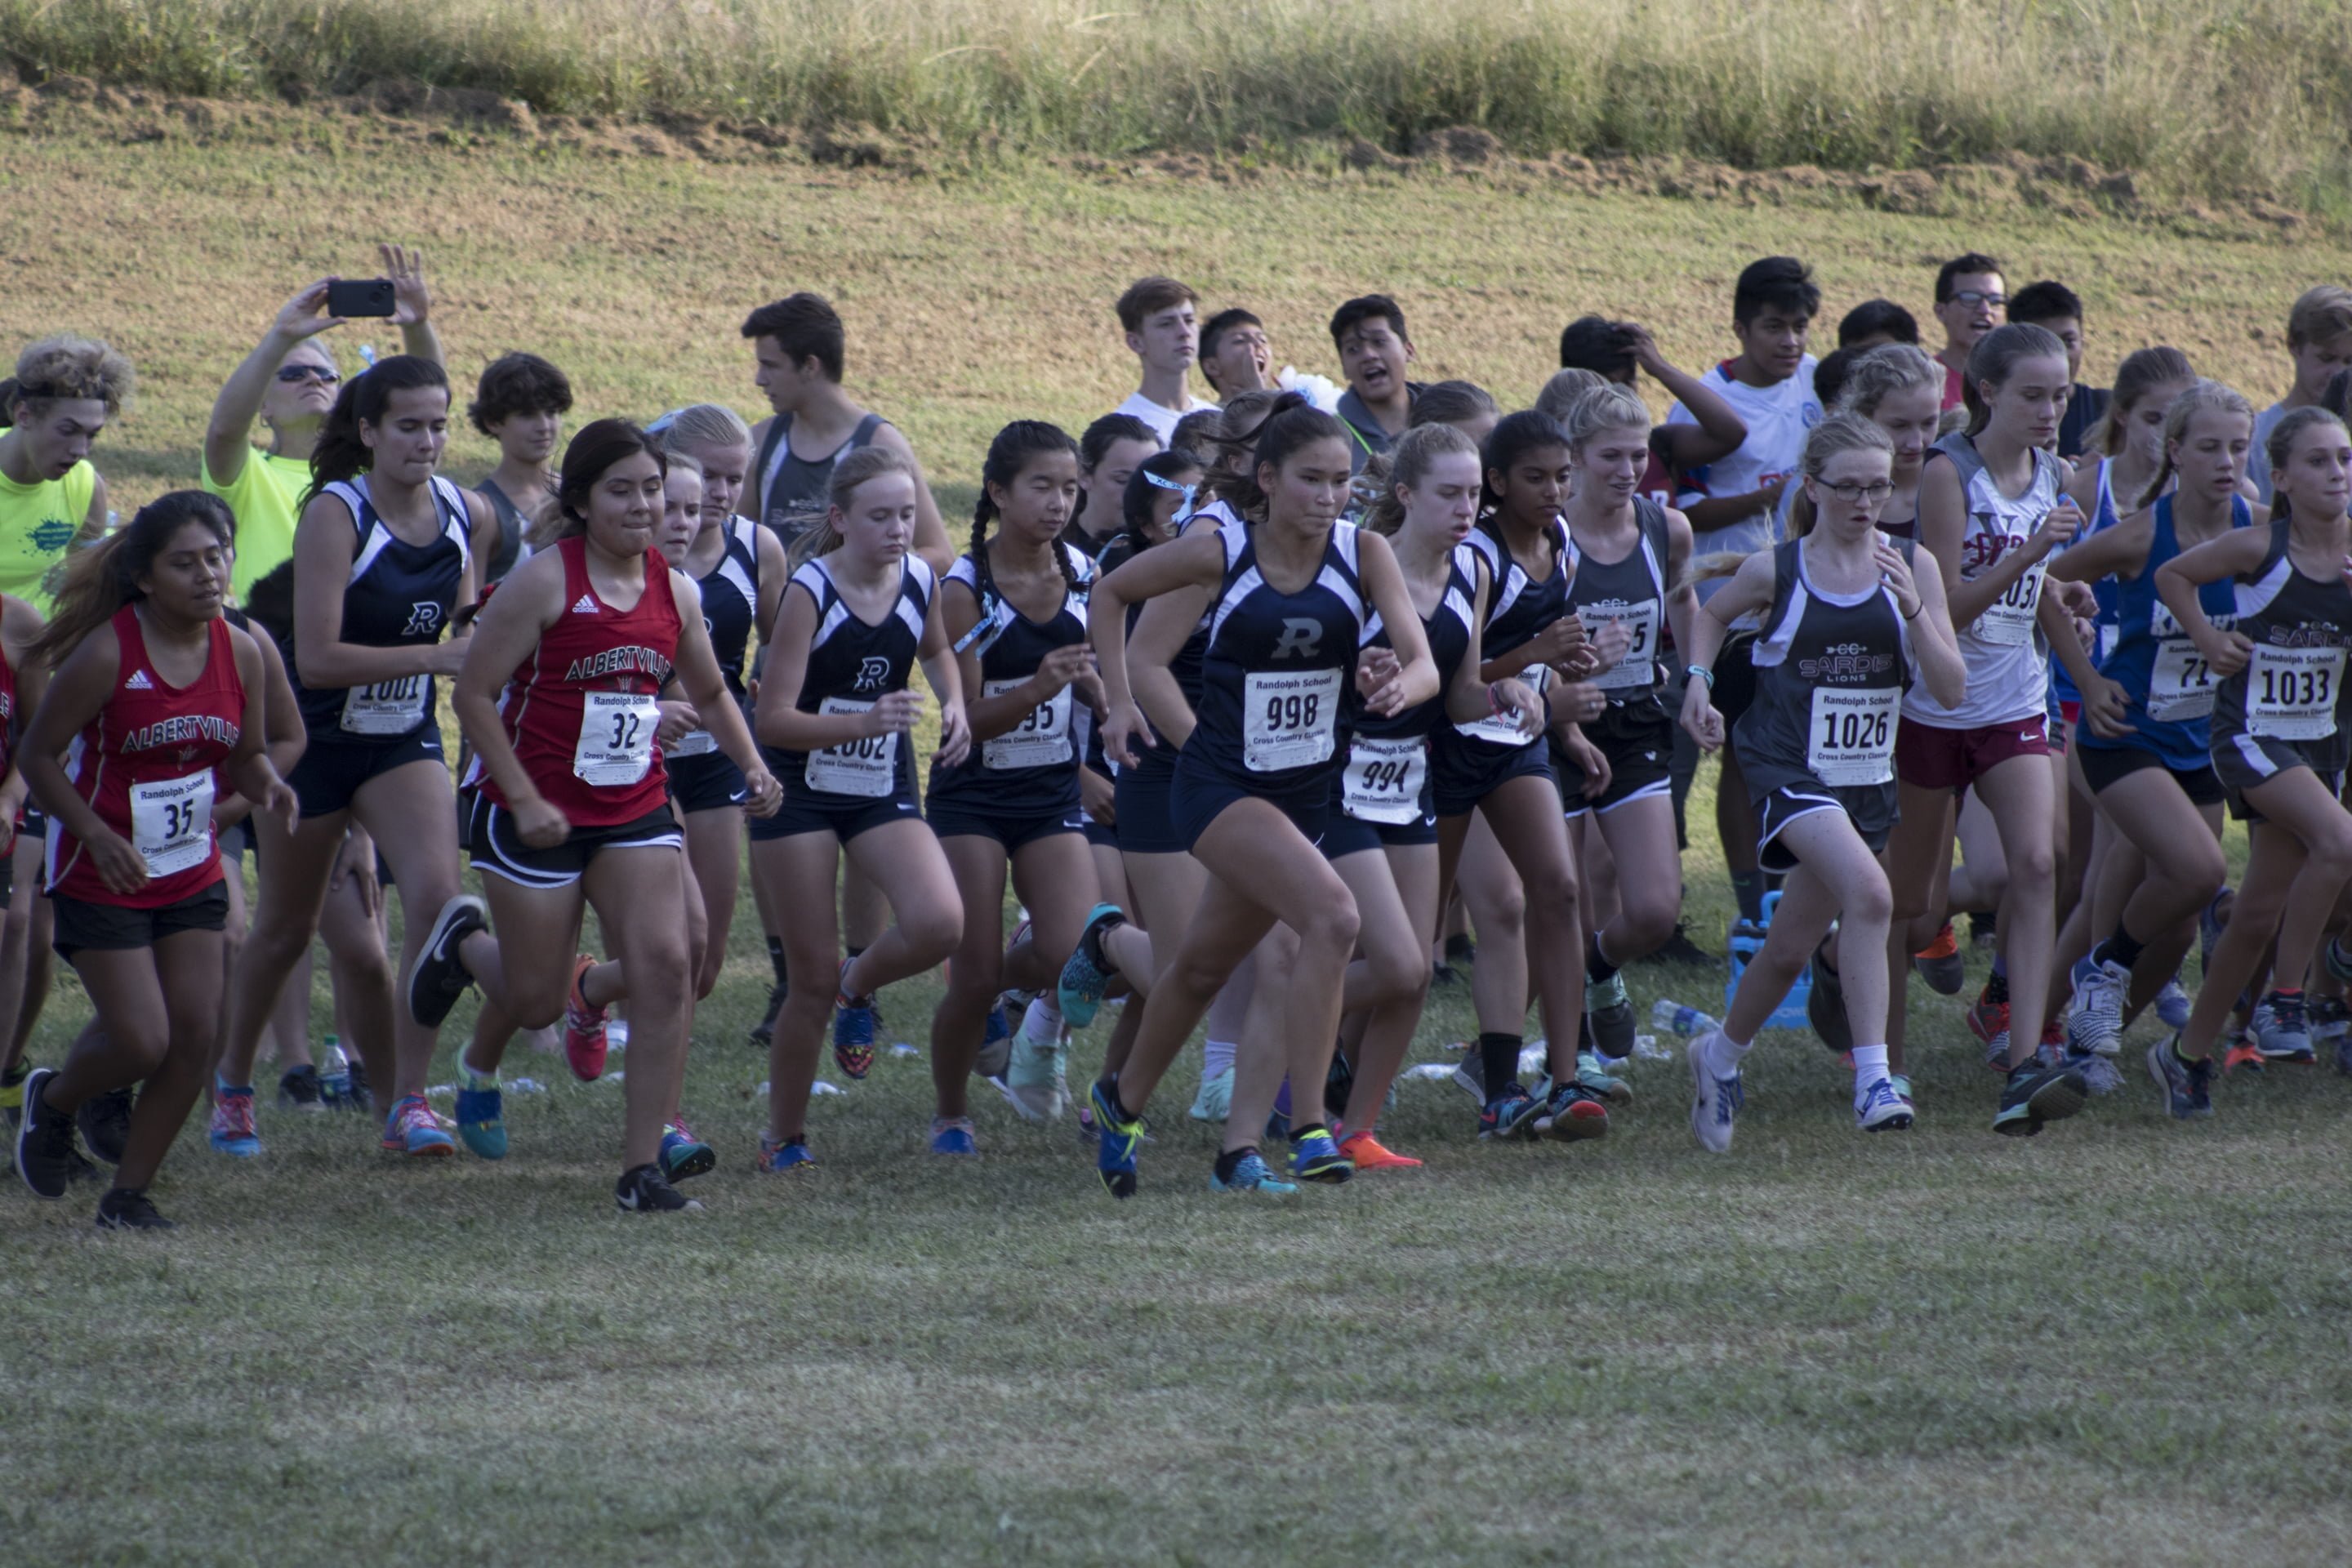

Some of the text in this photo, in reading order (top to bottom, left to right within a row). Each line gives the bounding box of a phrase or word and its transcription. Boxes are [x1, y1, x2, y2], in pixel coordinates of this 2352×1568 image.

[400, 601, 439, 635] R
[1627, 608, 1651, 621] School
[1270, 617, 1323, 659] R
[1799, 653, 1894, 677] SARDIS
[2260, 652, 2336, 665] Randolph School
[853, 656, 889, 693] R
[1827, 675, 1867, 683] LIONS
[2180, 657, 2209, 688] 71
[1256, 676, 1332, 689] Randolph School
[2261, 668, 2331, 705] 1033
[372, 703, 398, 711] Country
[594, 697, 631, 707] Randolph
[1824, 695, 1894, 707] Randolph School
[1009, 700, 1054, 733] 95
[1267, 693, 1319, 731] 998
[2255, 707, 2277, 716] Cross
[2278, 708, 2308, 718] Country
[120, 715, 239, 754] ALBERTVILLE
[608, 712, 639, 750] 32
[1823, 711, 1889, 749] 1026
[1013, 736, 1040, 744] Country
[1253, 737, 1274, 745] Cross
[1276, 733, 1302, 744] Country
[822, 733, 888, 760] 002
[1359, 743, 1397, 756] Randolph
[584, 751, 604, 760] Cross
[605, 752, 630, 761] Country
[1817, 751, 1889, 761] Cross Country Classic
[816, 758, 835, 767] Cross
[836, 760, 865, 770] Country
[1362, 760, 1410, 793] 994
[140, 775, 206, 800] Randolph School
[1351, 792, 1411, 804] Cross Country Classic
[164, 799, 194, 840] 35
[142, 845, 163, 854] Cross
